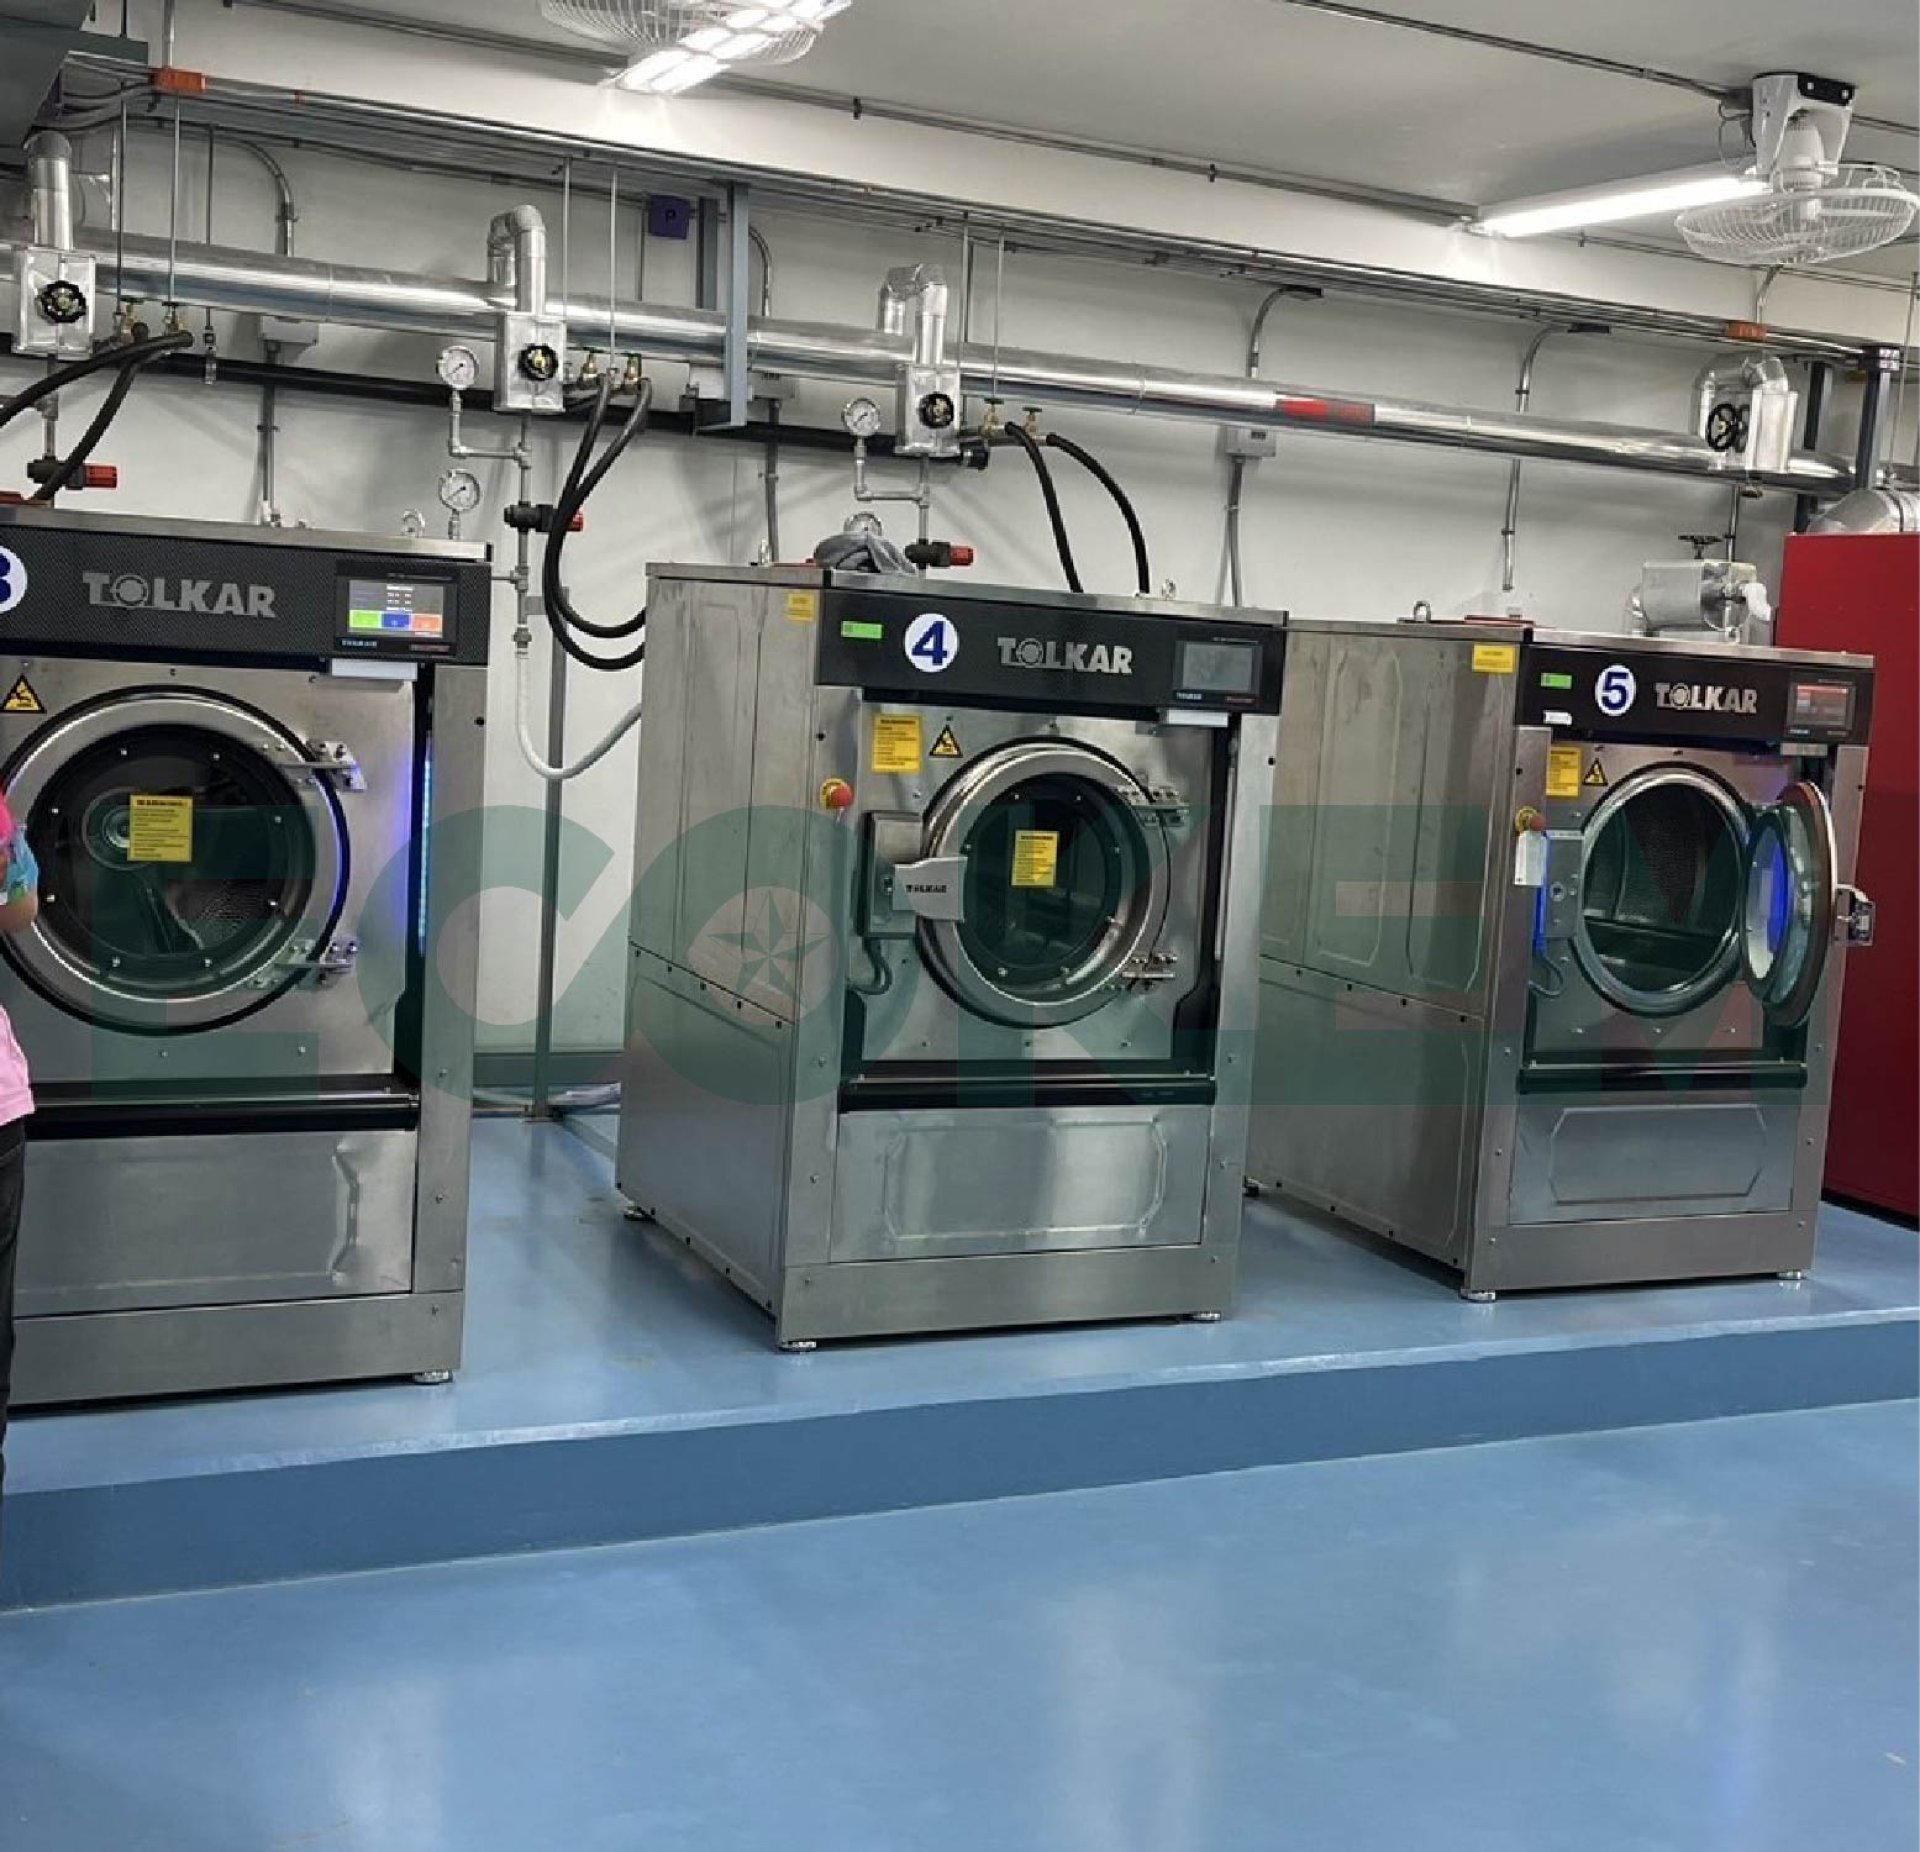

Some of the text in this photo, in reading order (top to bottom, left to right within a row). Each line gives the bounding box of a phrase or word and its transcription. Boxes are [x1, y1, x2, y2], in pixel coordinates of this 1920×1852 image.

[83, 570, 277, 619] TOLKAR
[911, 620, 948, 667] 4
[997, 636, 1133, 675] TOLKAR
[1602, 671, 1630, 711] 5
[1655, 682, 1758, 714] TOLKAR
